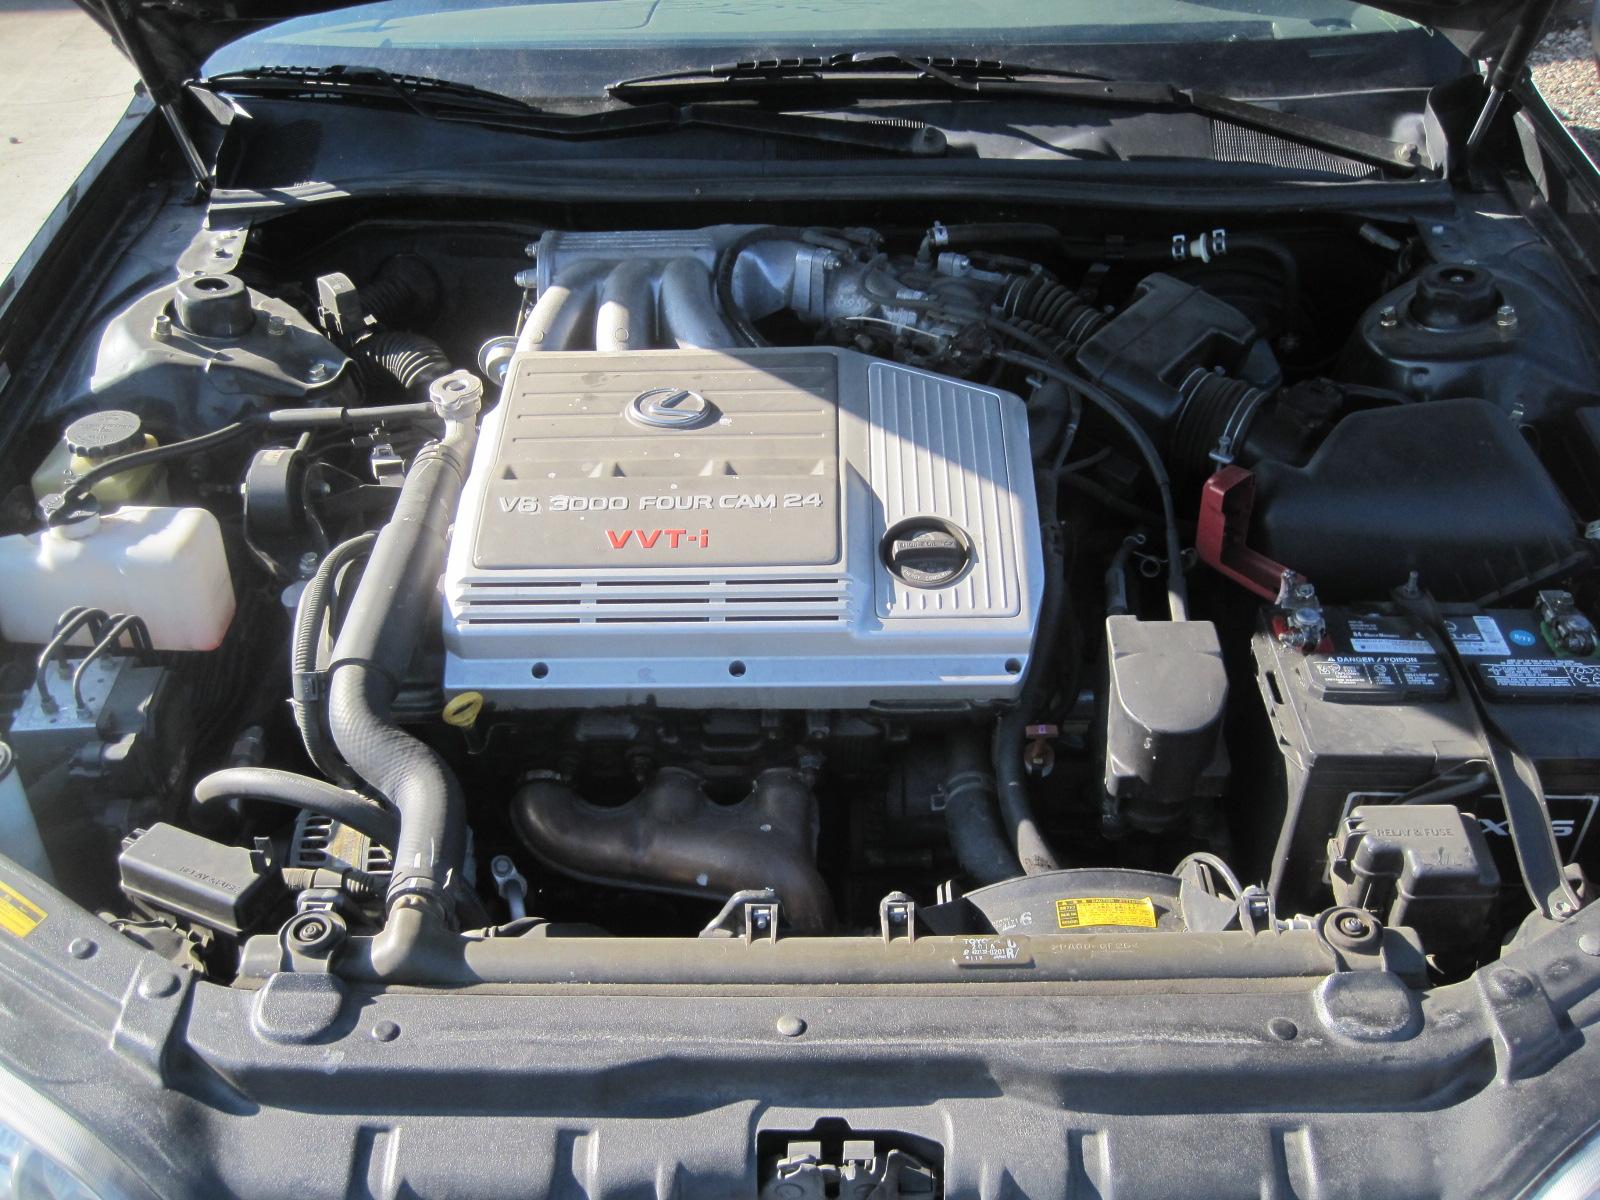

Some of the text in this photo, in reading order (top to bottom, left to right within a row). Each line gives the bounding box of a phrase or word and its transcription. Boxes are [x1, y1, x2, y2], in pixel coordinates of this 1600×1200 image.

[499, 493, 823, 512] V6 3000 FOUR CAM 24
[605, 528, 709, 550] VVT-i
[1376, 828, 1411, 837] RELAY
[1425, 828, 1453, 837] FUSE
